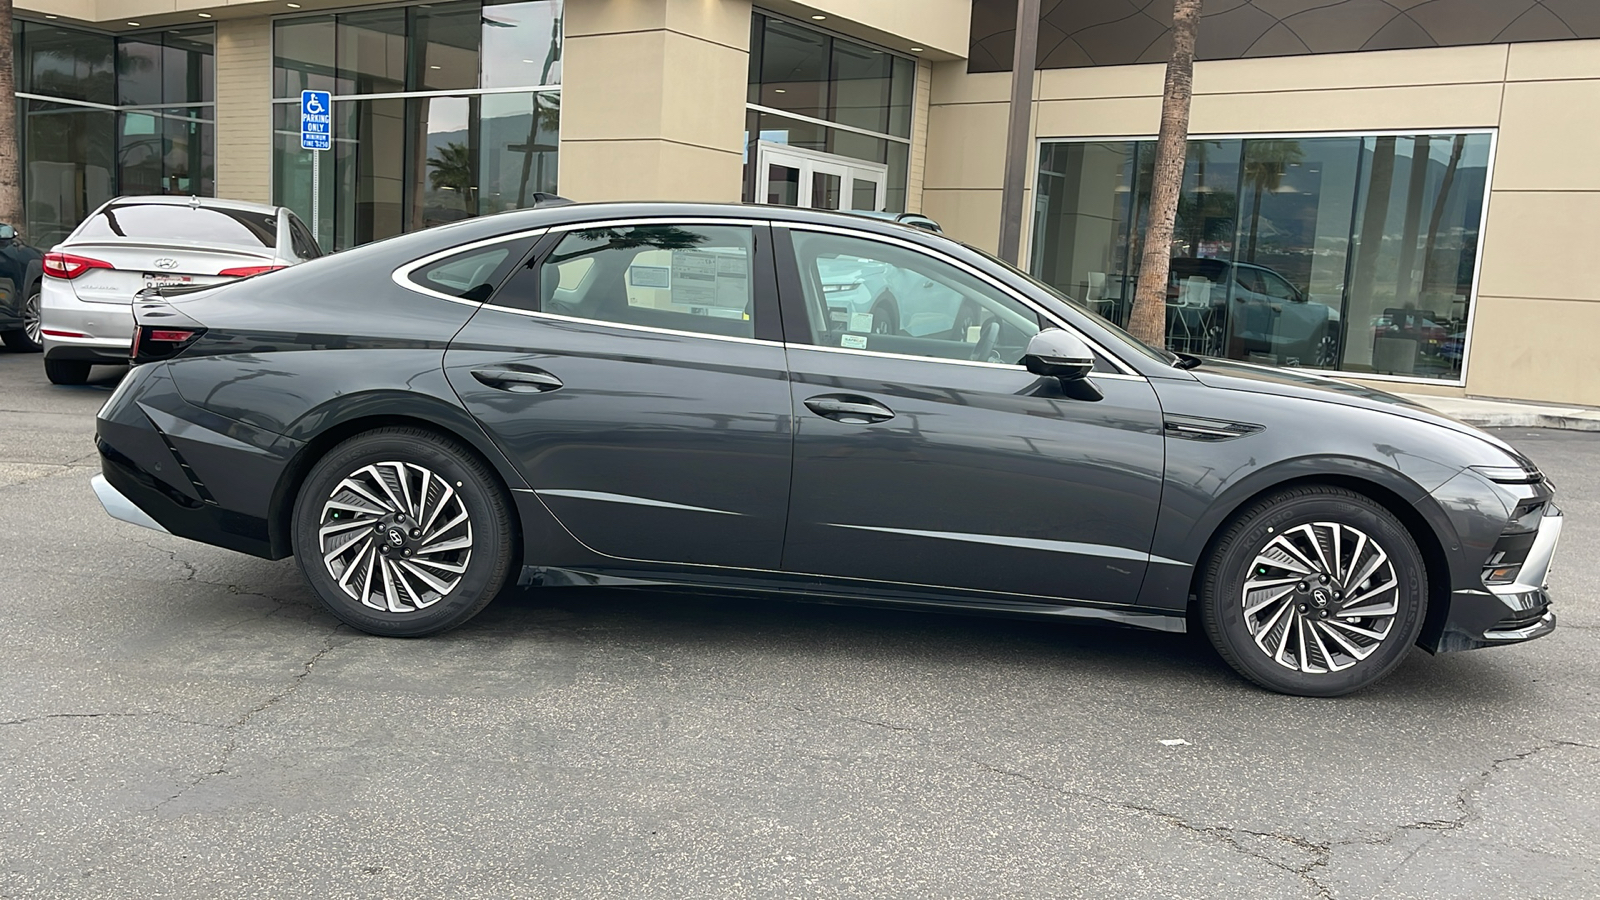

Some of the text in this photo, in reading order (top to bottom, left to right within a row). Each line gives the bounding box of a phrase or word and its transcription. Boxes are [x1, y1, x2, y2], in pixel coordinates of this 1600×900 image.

[303, 113, 329, 123] PARKING
[307, 123, 324, 132] ONLY
[1243, 510, 1294, 550] KUMHO
[1407, 566, 1418, 623] SOLUS
